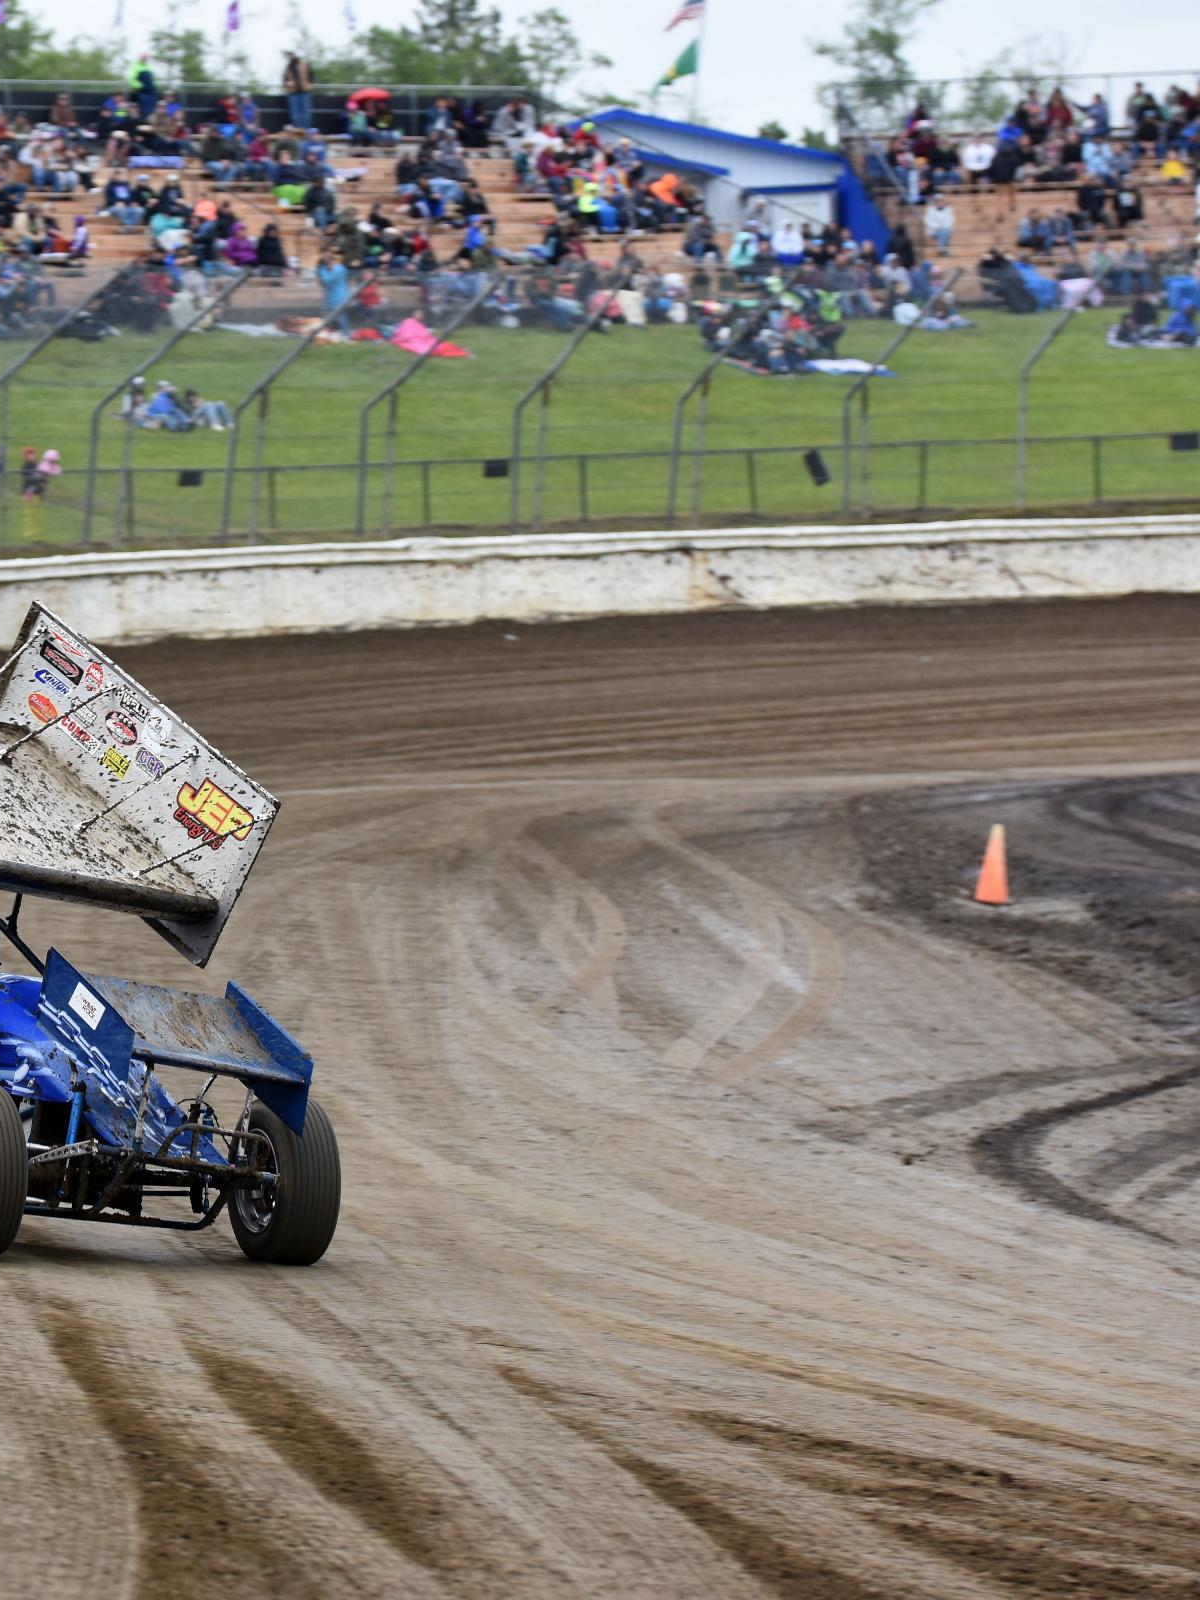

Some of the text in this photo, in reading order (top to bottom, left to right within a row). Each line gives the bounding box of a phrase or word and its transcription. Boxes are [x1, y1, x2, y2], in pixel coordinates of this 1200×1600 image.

[61, 716, 91, 742] COMP
[173, 808, 206, 839] Energy
[177, 777, 254, 841] JEP
